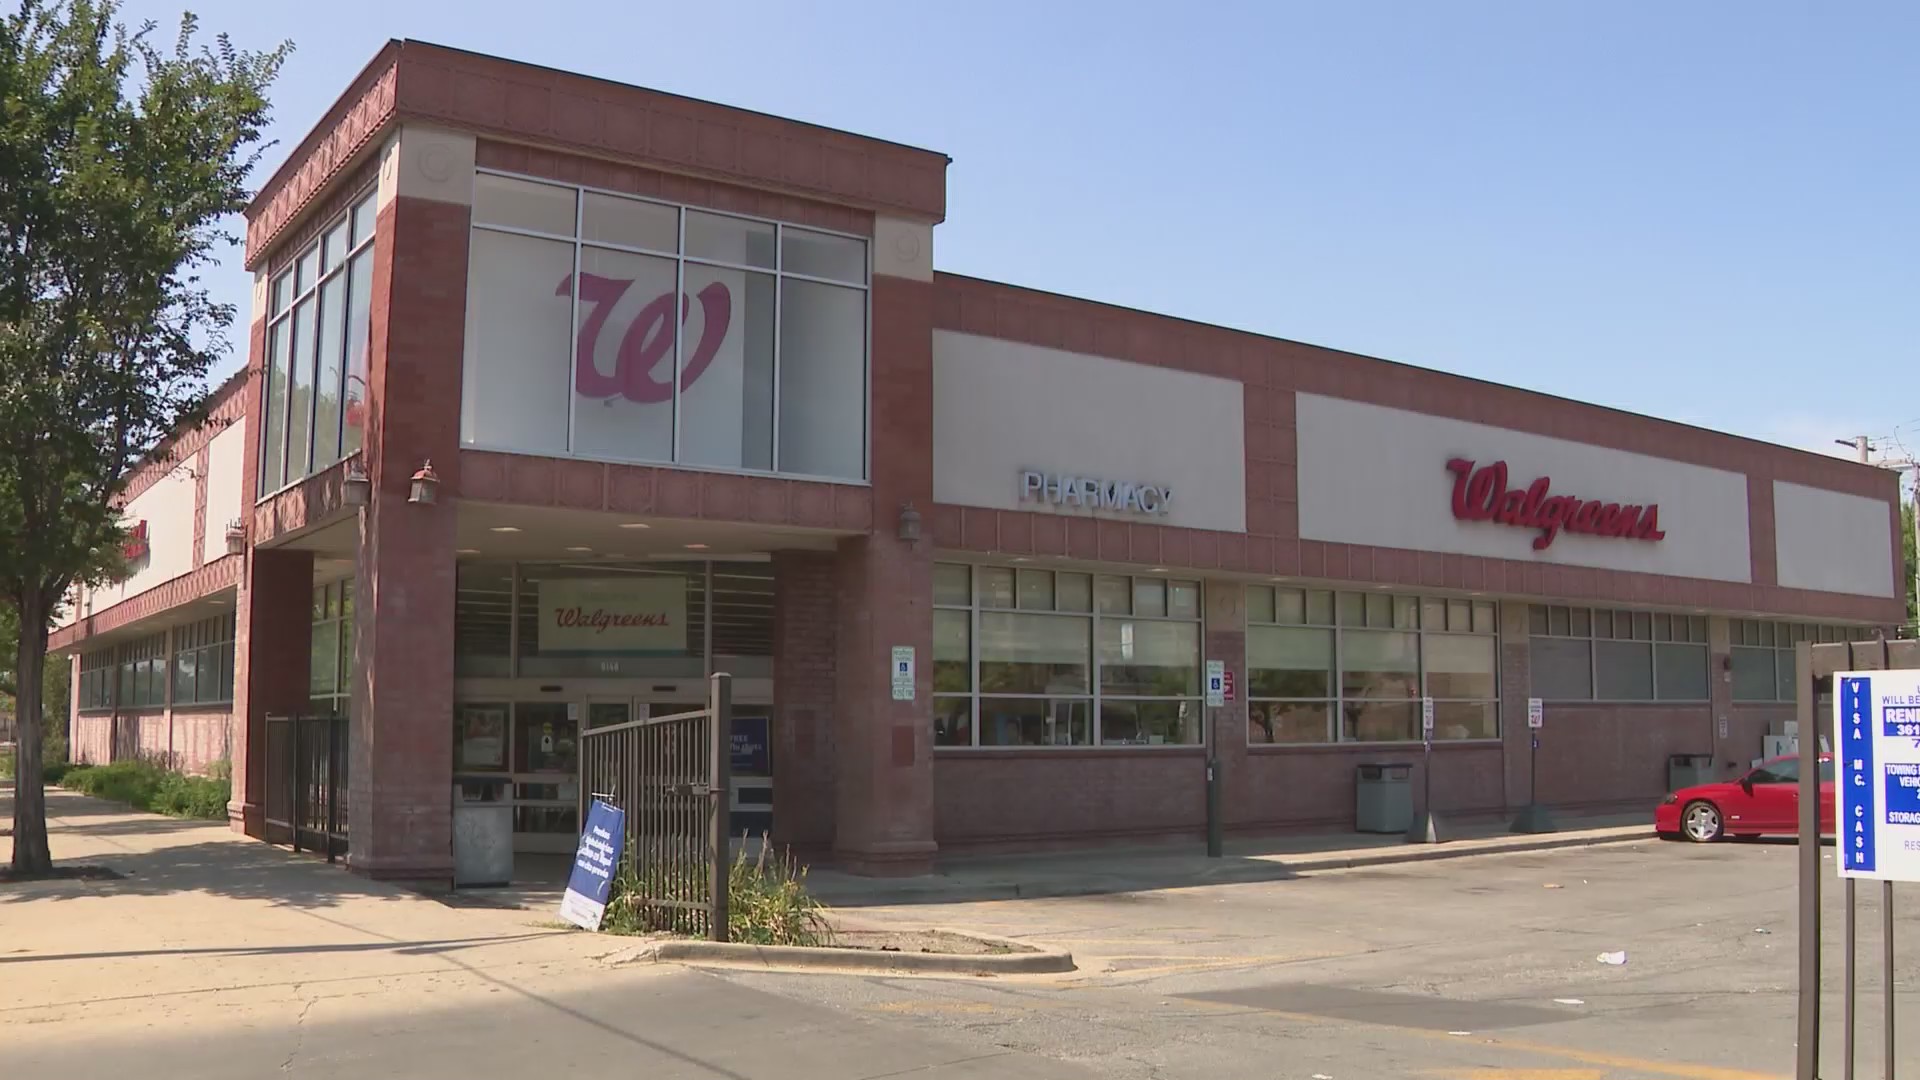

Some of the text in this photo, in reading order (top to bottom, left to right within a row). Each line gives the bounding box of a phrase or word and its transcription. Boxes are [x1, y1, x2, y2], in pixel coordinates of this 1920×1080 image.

[555, 272, 731, 404] W
[1022, 471, 1174, 514] PHARMACY
[1446, 458, 1666, 551] Walgreens
[554, 607, 669, 634] Walgreens
[1851, 682, 1862, 740] VISA
[1882, 695, 1905, 705] WILL
[1886, 764, 1917, 775] TOWING
[1854, 804, 1864, 864] CASH
